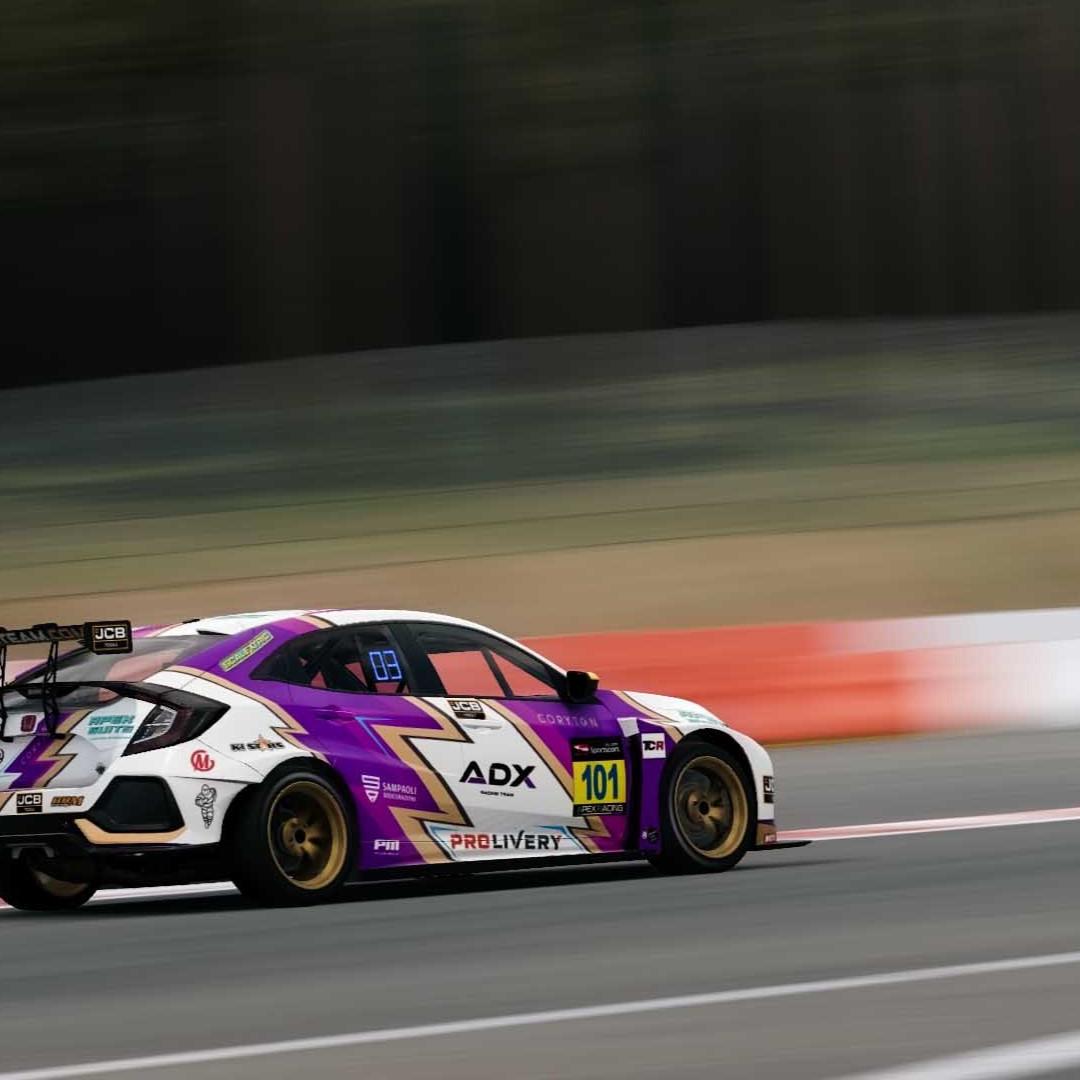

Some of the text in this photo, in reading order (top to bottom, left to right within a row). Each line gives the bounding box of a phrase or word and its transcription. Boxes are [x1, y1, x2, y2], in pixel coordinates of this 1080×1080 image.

[95, 627, 126, 639] JCB
[368, 650, 402, 681] 03
[452, 702, 482, 711] JCB
[538, 713, 598, 728] CORYTON
[642, 740, 665, 751] TCR
[459, 760, 536, 789] ADX
[581, 763, 619, 800] 101
[382, 782, 417, 795] SAMPAOLI
[17, 794, 41, 805] JCB
[450, 831, 562, 850] PROLIVERY
